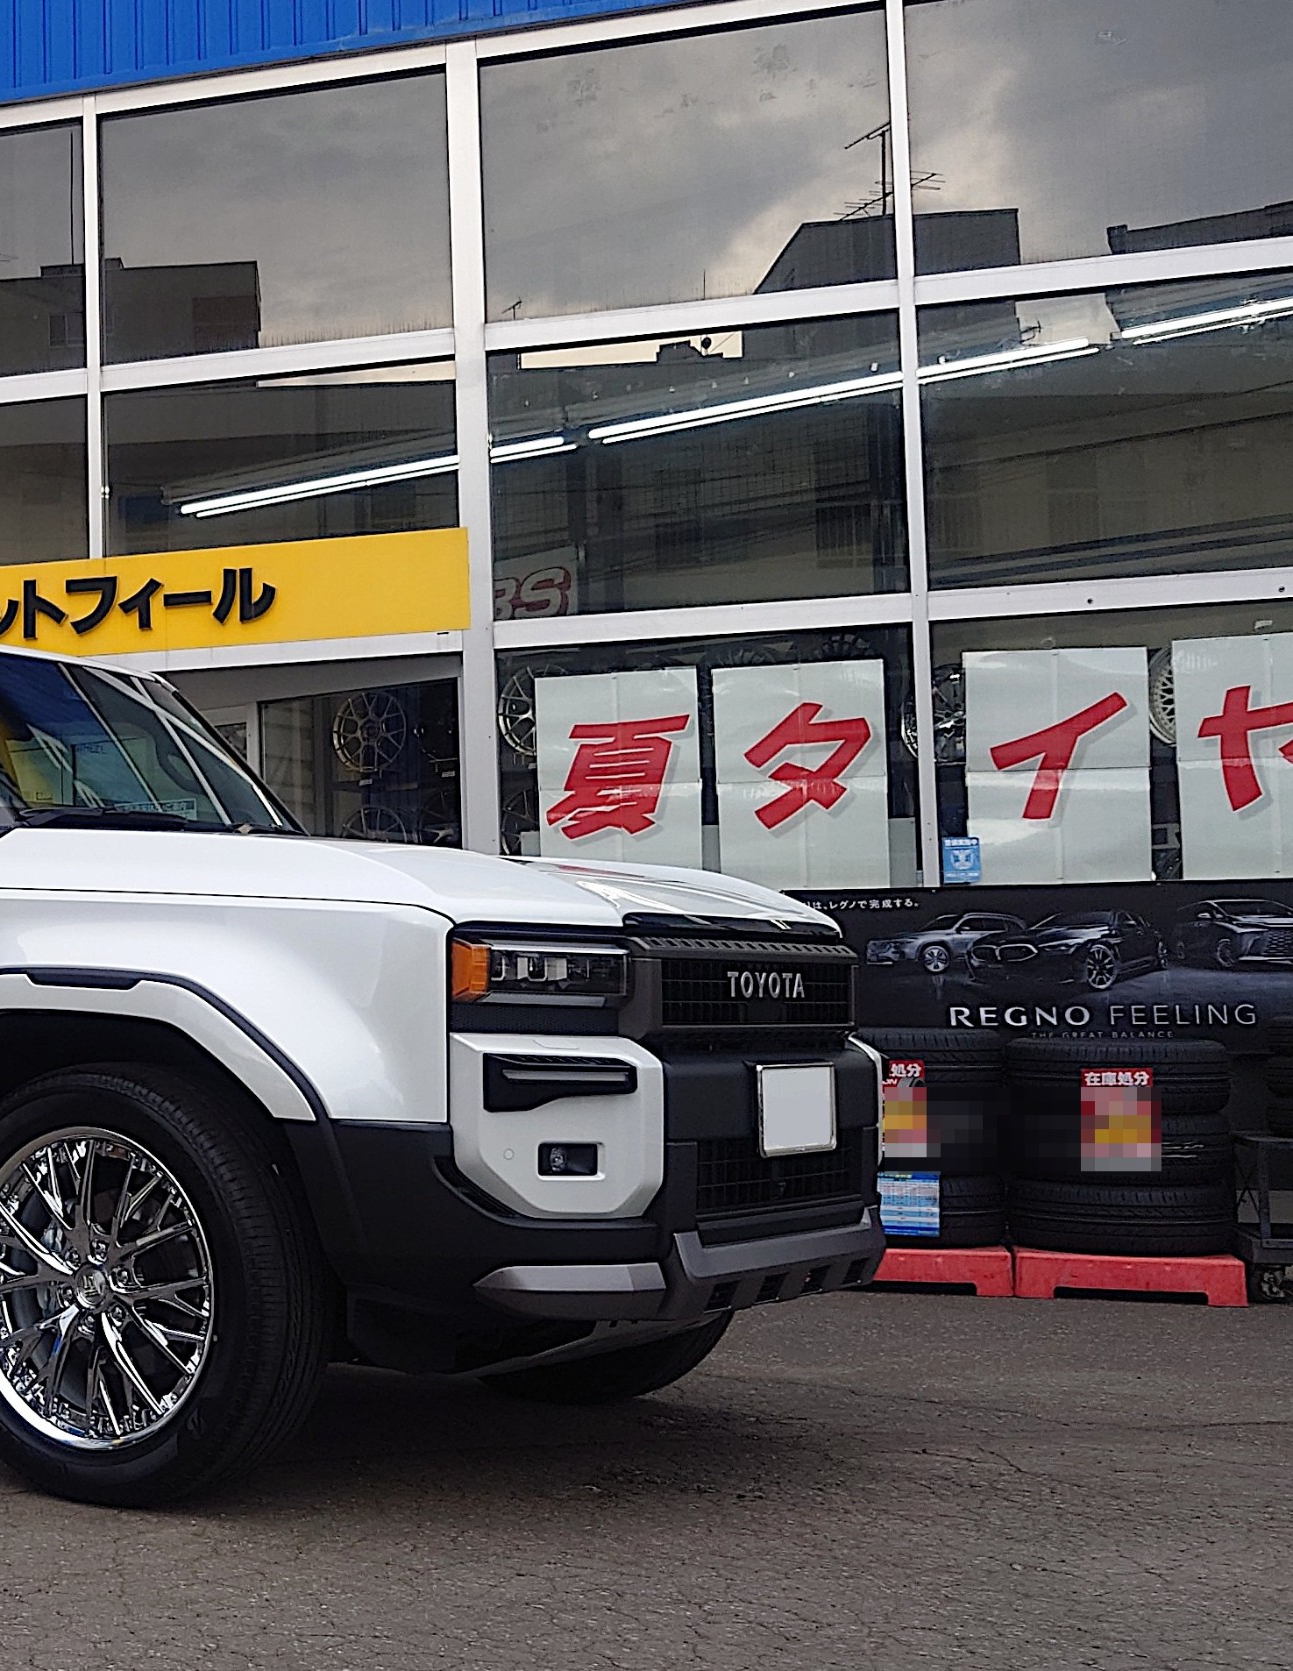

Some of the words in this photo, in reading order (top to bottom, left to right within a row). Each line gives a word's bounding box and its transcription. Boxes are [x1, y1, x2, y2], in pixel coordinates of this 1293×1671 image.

[727, 971, 805, 998] TOYOTA
[950, 1006, 1090, 1027] REGNO
[1110, 1004, 1256, 1025] FEELING
[1084, 1071, 1149, 1086] 在庫処分
